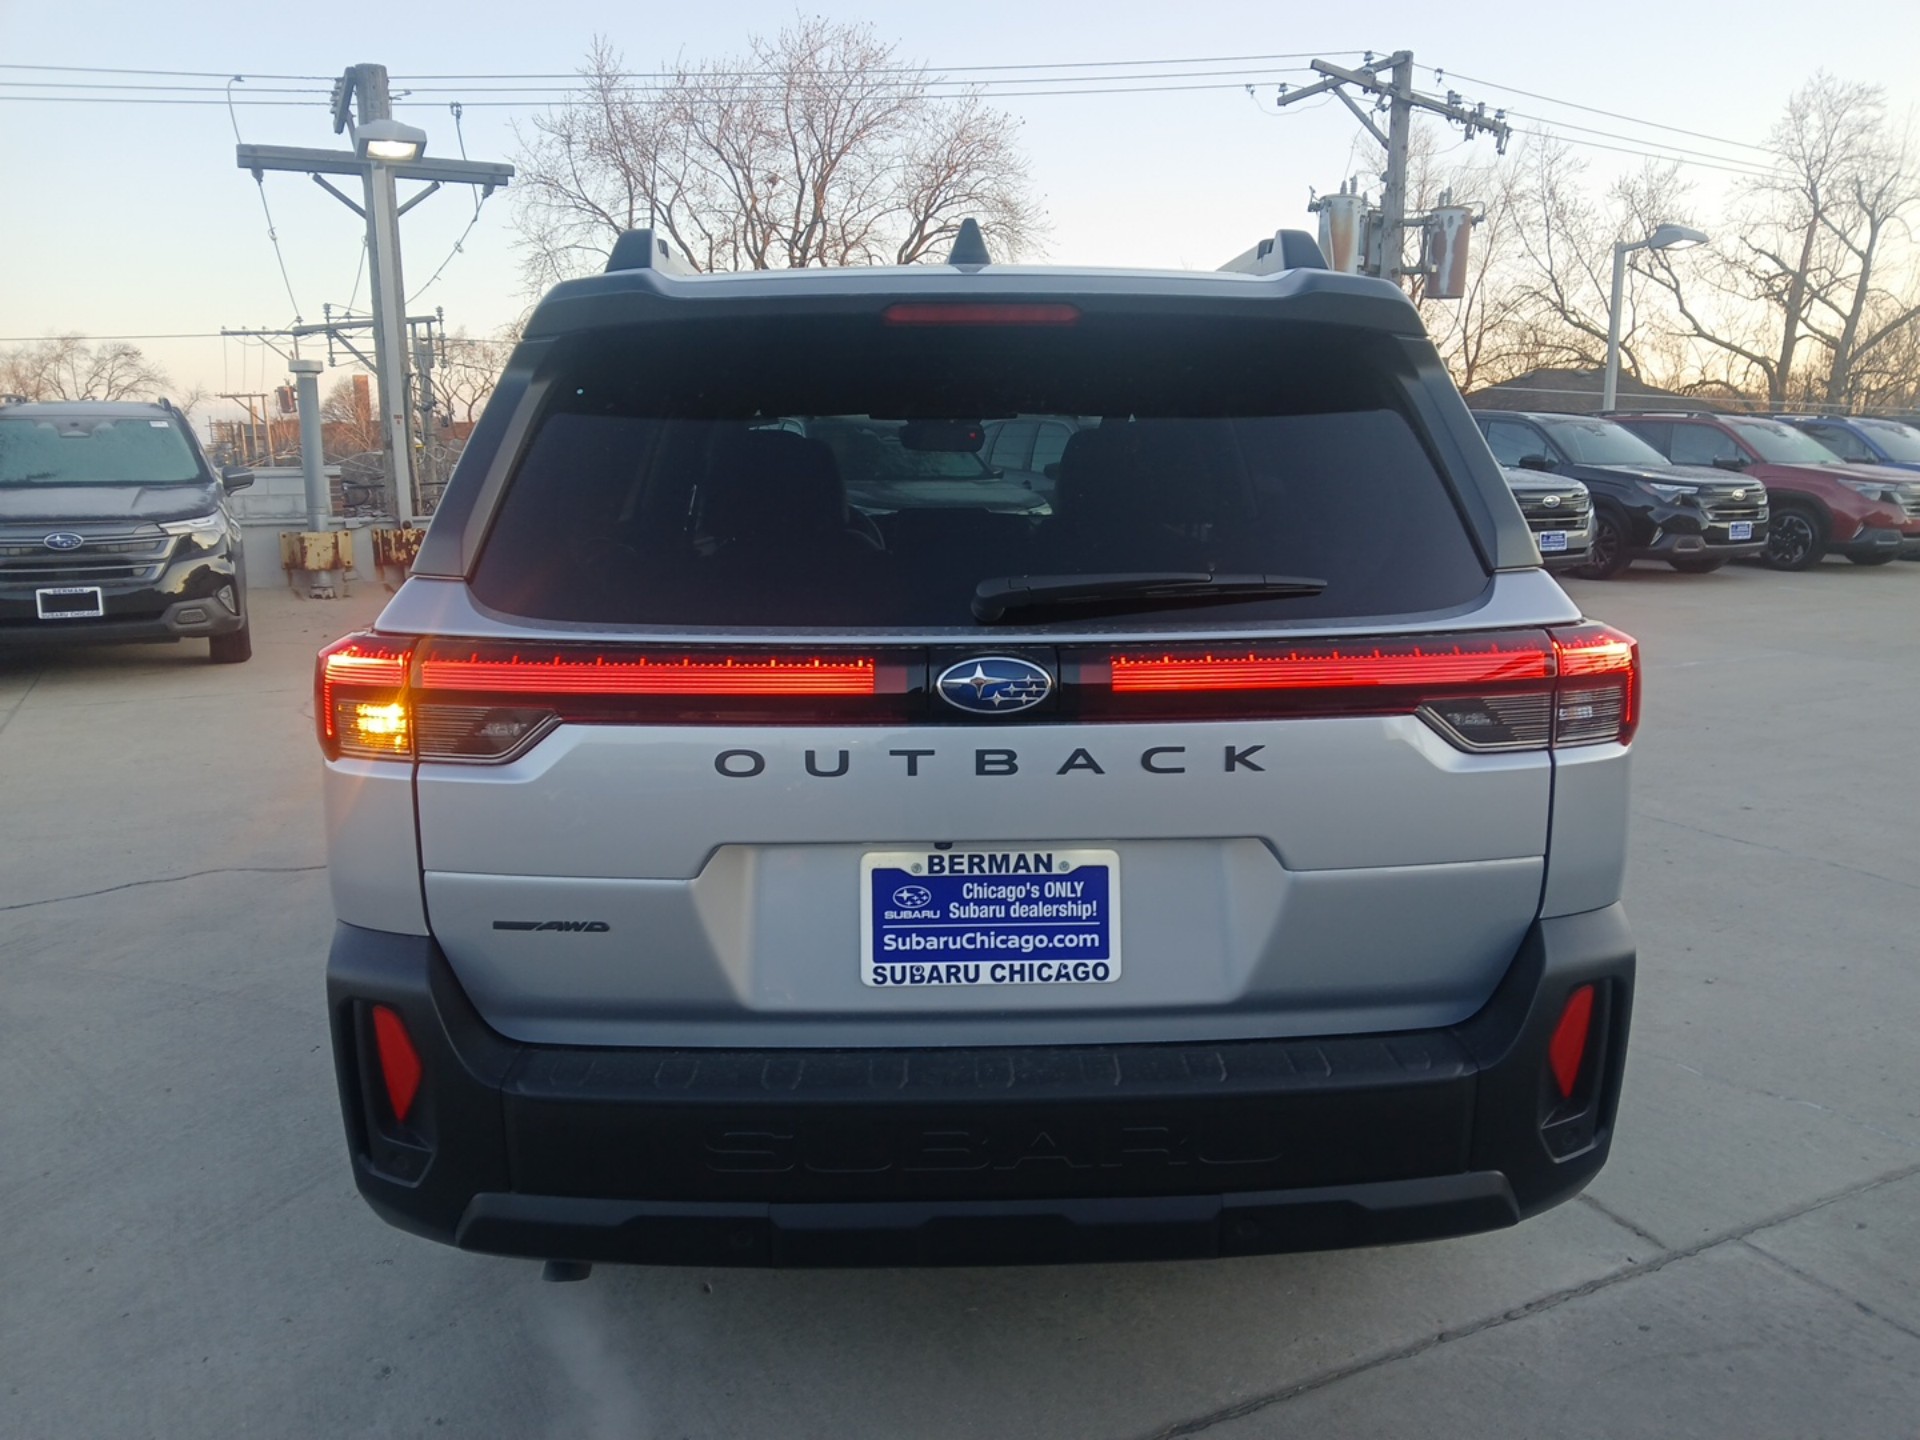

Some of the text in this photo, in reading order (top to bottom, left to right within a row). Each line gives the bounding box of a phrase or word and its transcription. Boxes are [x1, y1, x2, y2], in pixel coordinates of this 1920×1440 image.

[713, 745, 1267, 778] OUTBACK
[927, 853, 1053, 875] BERMAN
[962, 881, 1084, 901] Chicago's ONLY
[884, 910, 940, 919] SUBARU
[949, 900, 1097, 920] Subaru dealership!
[535, 921, 610, 932] AWD
[883, 931, 1100, 952] SubaruChicago.com
[872, 962, 1110, 985] SUBARU CHICAGO
[704, 1126, 1284, 1173] SUBARU
